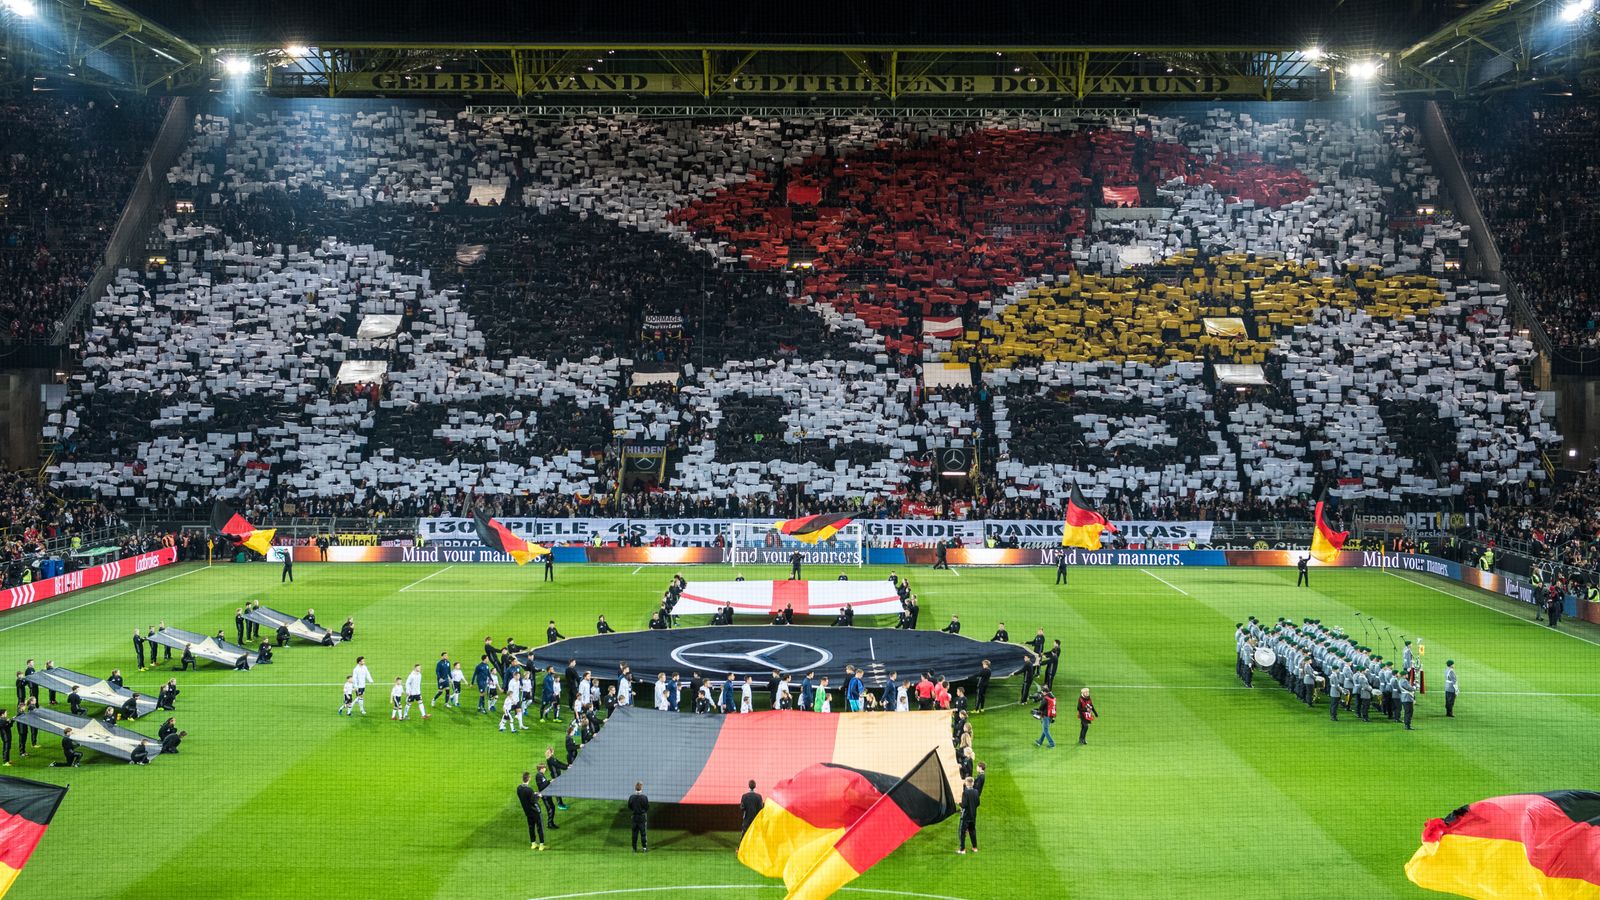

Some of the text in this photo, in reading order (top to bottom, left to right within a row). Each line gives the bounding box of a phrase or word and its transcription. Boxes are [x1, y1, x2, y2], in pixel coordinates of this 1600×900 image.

[371, 73, 505, 90] GELBE
[529, 74, 648, 90] WAND
[991, 76, 1230, 93] DORTMUND
[626, 445, 664, 454] HILDEN
[1355, 512, 1406, 525] HERBORN
[426, 521, 477, 534] 130
[505, 521, 600, 539] PIELE,
[654, 522, 740, 538] TORE,
[837, 522, 974, 537] EGENDE.
[986, 524, 1064, 537] DANK
[1102, 524, 1197, 538] UKAS.
[402, 546, 546, 563] Mind your mans.
[722, 547, 758, 563] Mind
[801, 550, 864, 564] manners.
[1040, 549, 1184, 566] Mnd your manners.
[1363, 551, 1400, 568] Mind
[1403, 557, 1425, 571] your
[1504, 577, 1519, 599] Mind
